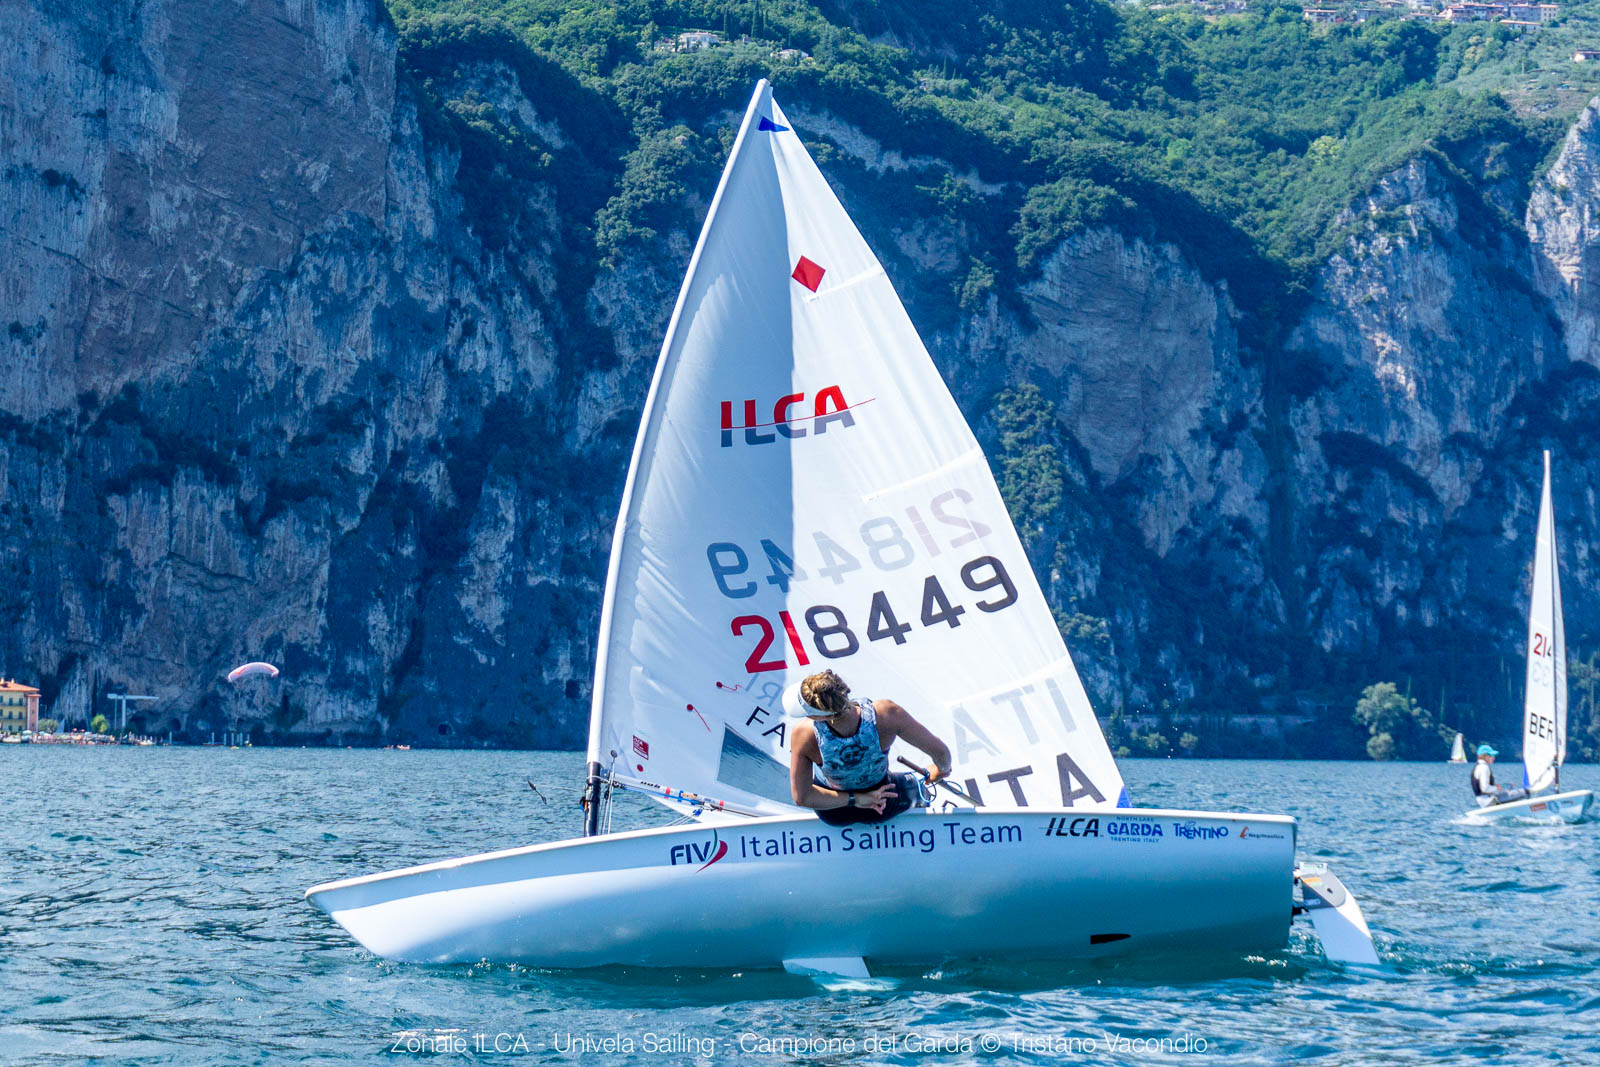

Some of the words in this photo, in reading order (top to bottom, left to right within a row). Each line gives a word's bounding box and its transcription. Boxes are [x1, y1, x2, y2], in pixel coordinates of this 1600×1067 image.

[720, 385, 856, 447] ILCA
[730, 555, 1019, 674] 218449
[745, 705, 787, 748] FA
[670, 840, 713, 865] FIV
[741, 831, 833, 858] Italian
[842, 824, 935, 853] Sailing
[943, 822, 1023, 845] Team
[1045, 817, 1099, 837] ILCA
[1107, 822, 1164, 836] GARDA
[1172, 822, 1229, 840] TRENTINO
